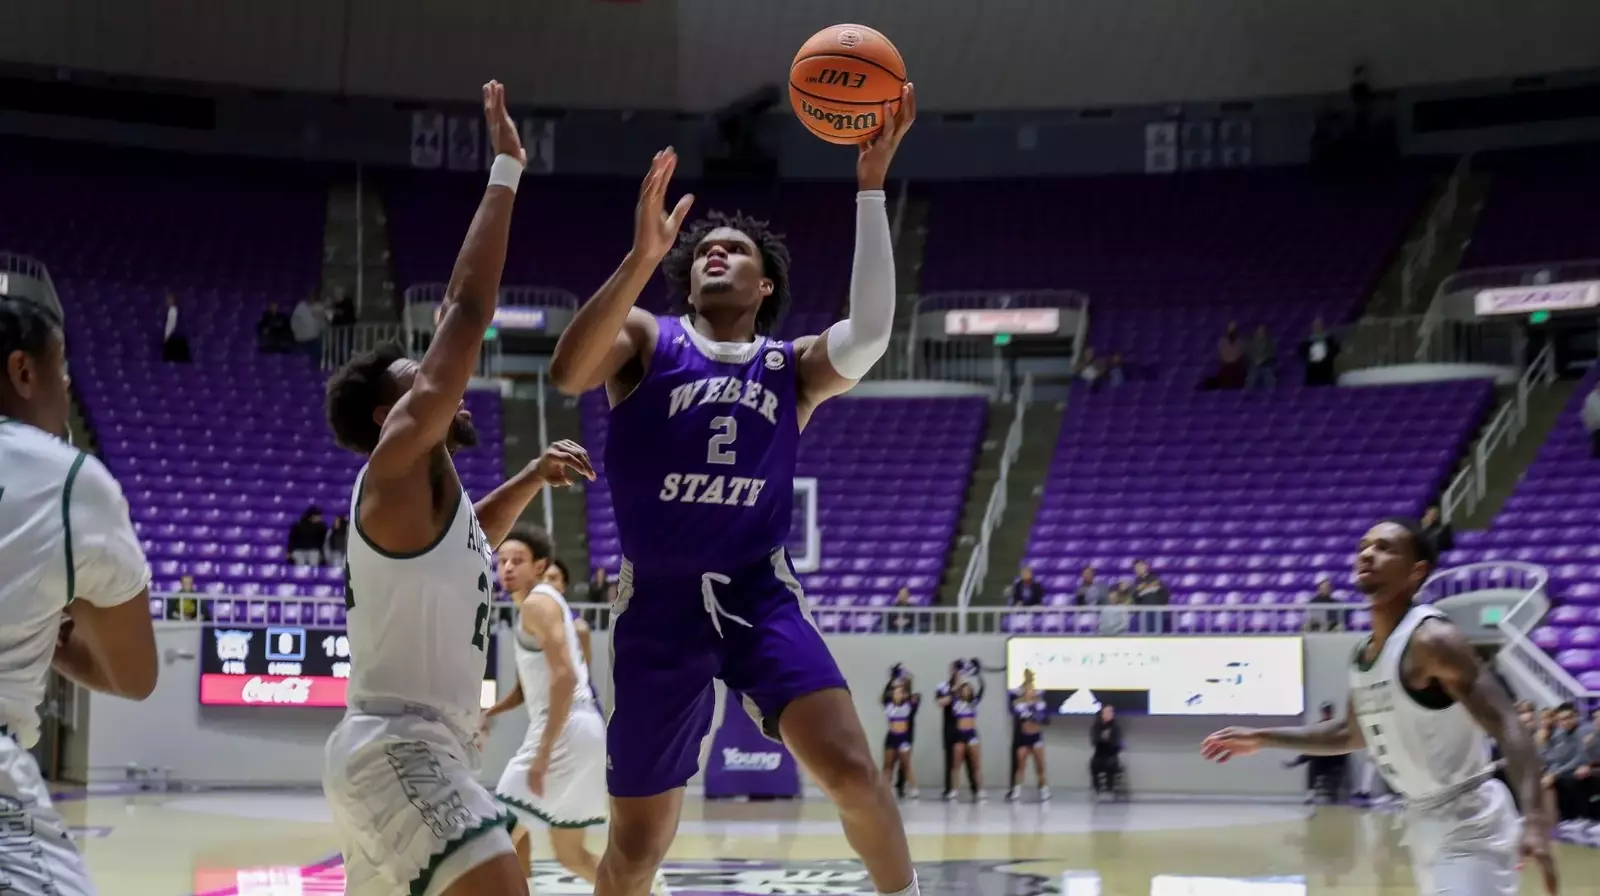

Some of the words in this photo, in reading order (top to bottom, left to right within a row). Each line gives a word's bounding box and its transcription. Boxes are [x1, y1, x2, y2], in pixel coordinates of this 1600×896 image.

[818, 69, 866, 88] EVO
[801, 99, 878, 130] Wilson
[669, 377, 778, 424] WEBER
[707, 415, 737, 464] 2
[660, 473, 766, 506] STATE
[722, 747, 782, 770] Young
